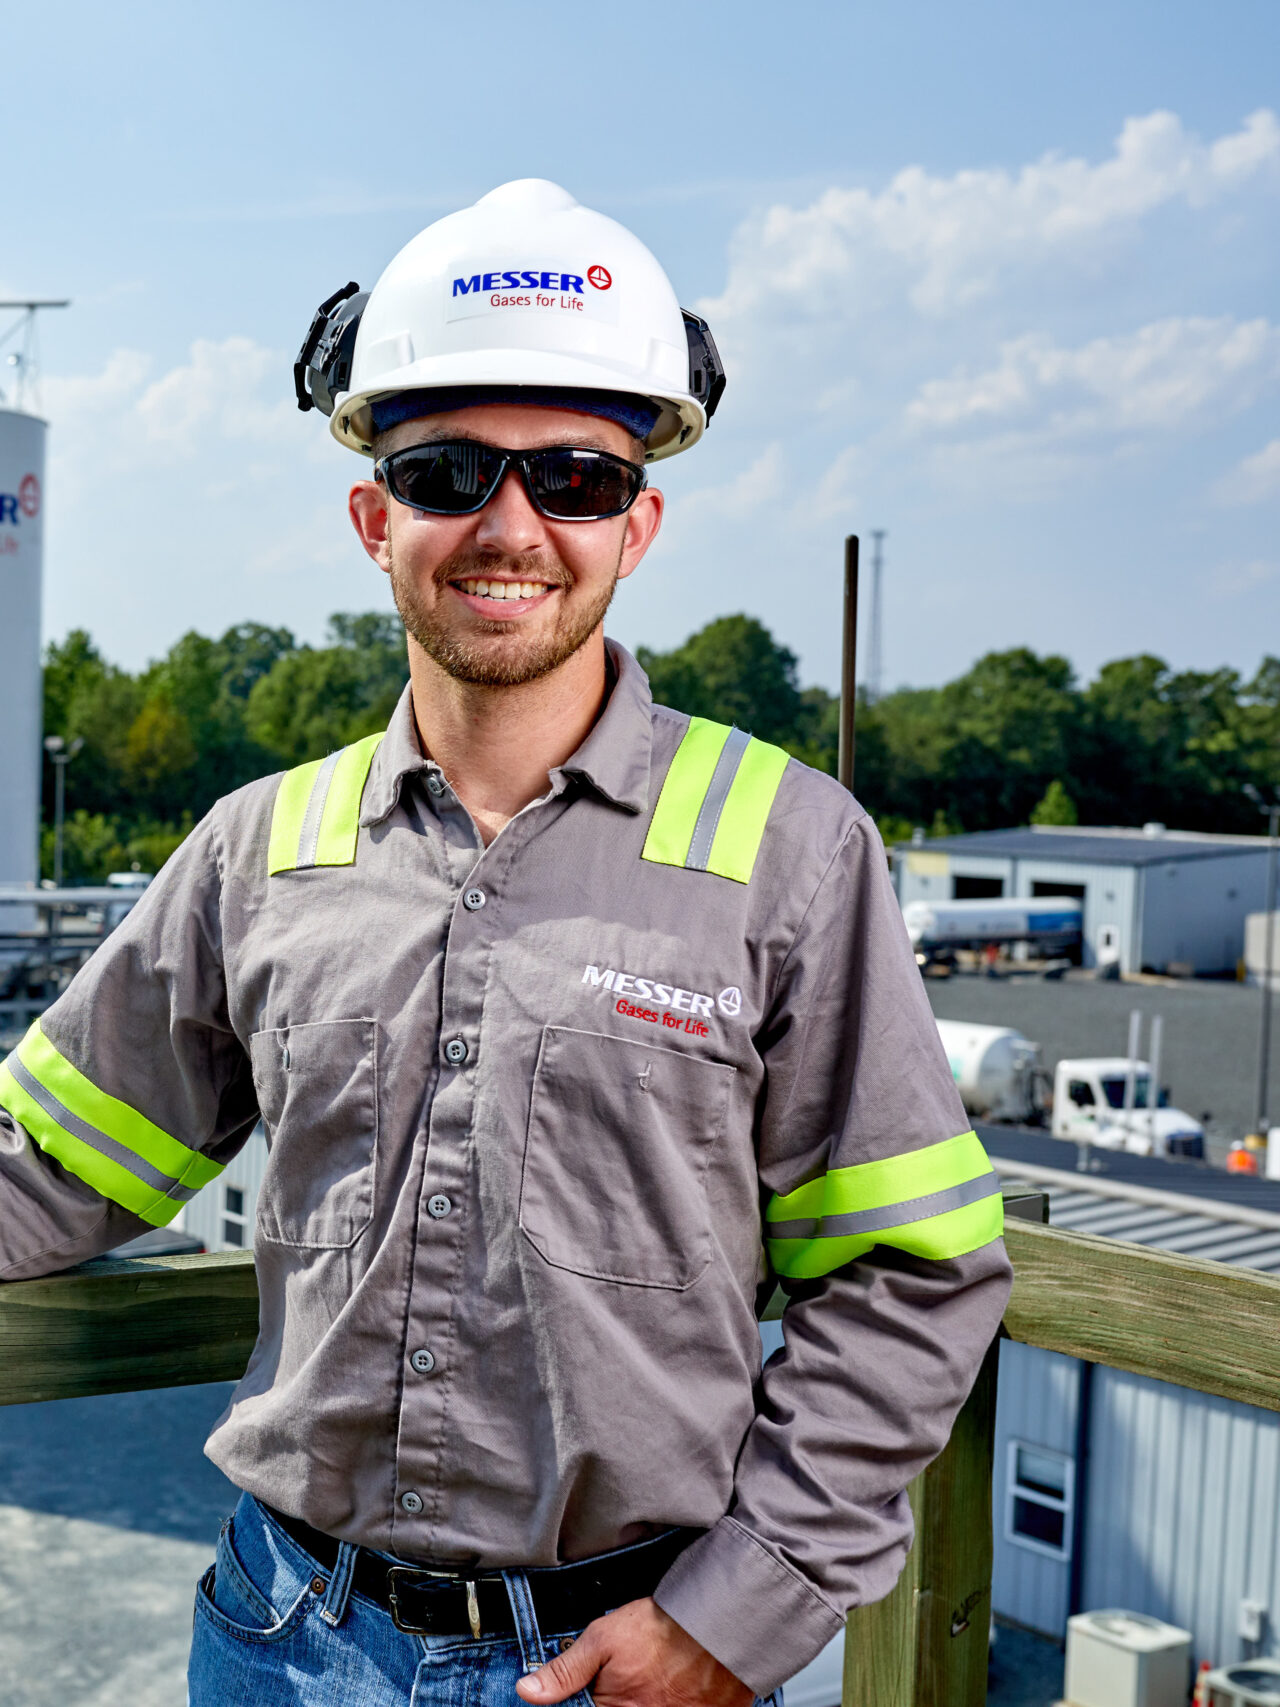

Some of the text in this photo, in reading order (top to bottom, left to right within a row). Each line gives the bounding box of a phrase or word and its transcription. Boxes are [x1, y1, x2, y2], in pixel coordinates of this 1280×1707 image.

[452, 271, 584, 297] MESSER
[490, 293, 584, 311] Gases for Life
[581, 964, 715, 1018] MESSER
[615, 998, 709, 1038] Gases for Life
